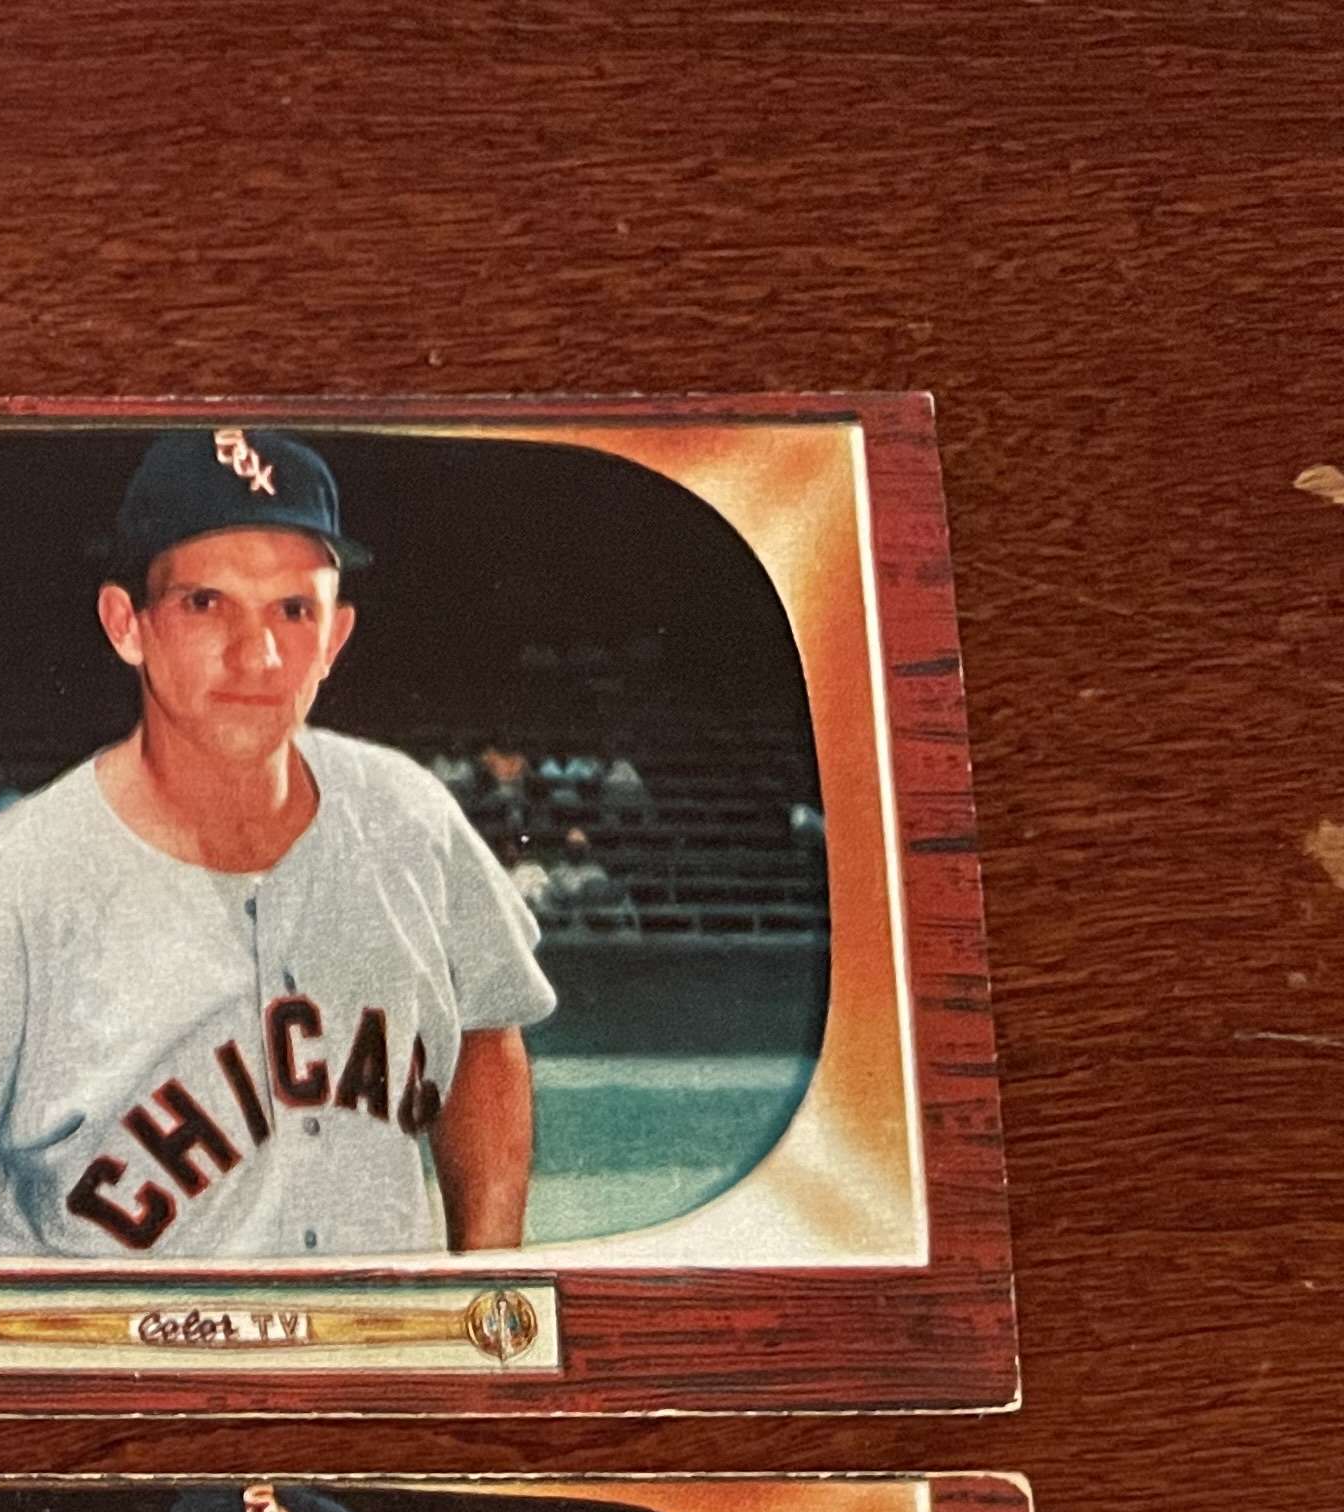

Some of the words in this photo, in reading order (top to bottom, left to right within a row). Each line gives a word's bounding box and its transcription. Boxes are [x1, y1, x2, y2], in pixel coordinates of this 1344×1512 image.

[213, 426, 276, 496] SOX
[138, 1309, 240, 1345] Color
[251, 1313, 298, 1342] TV
